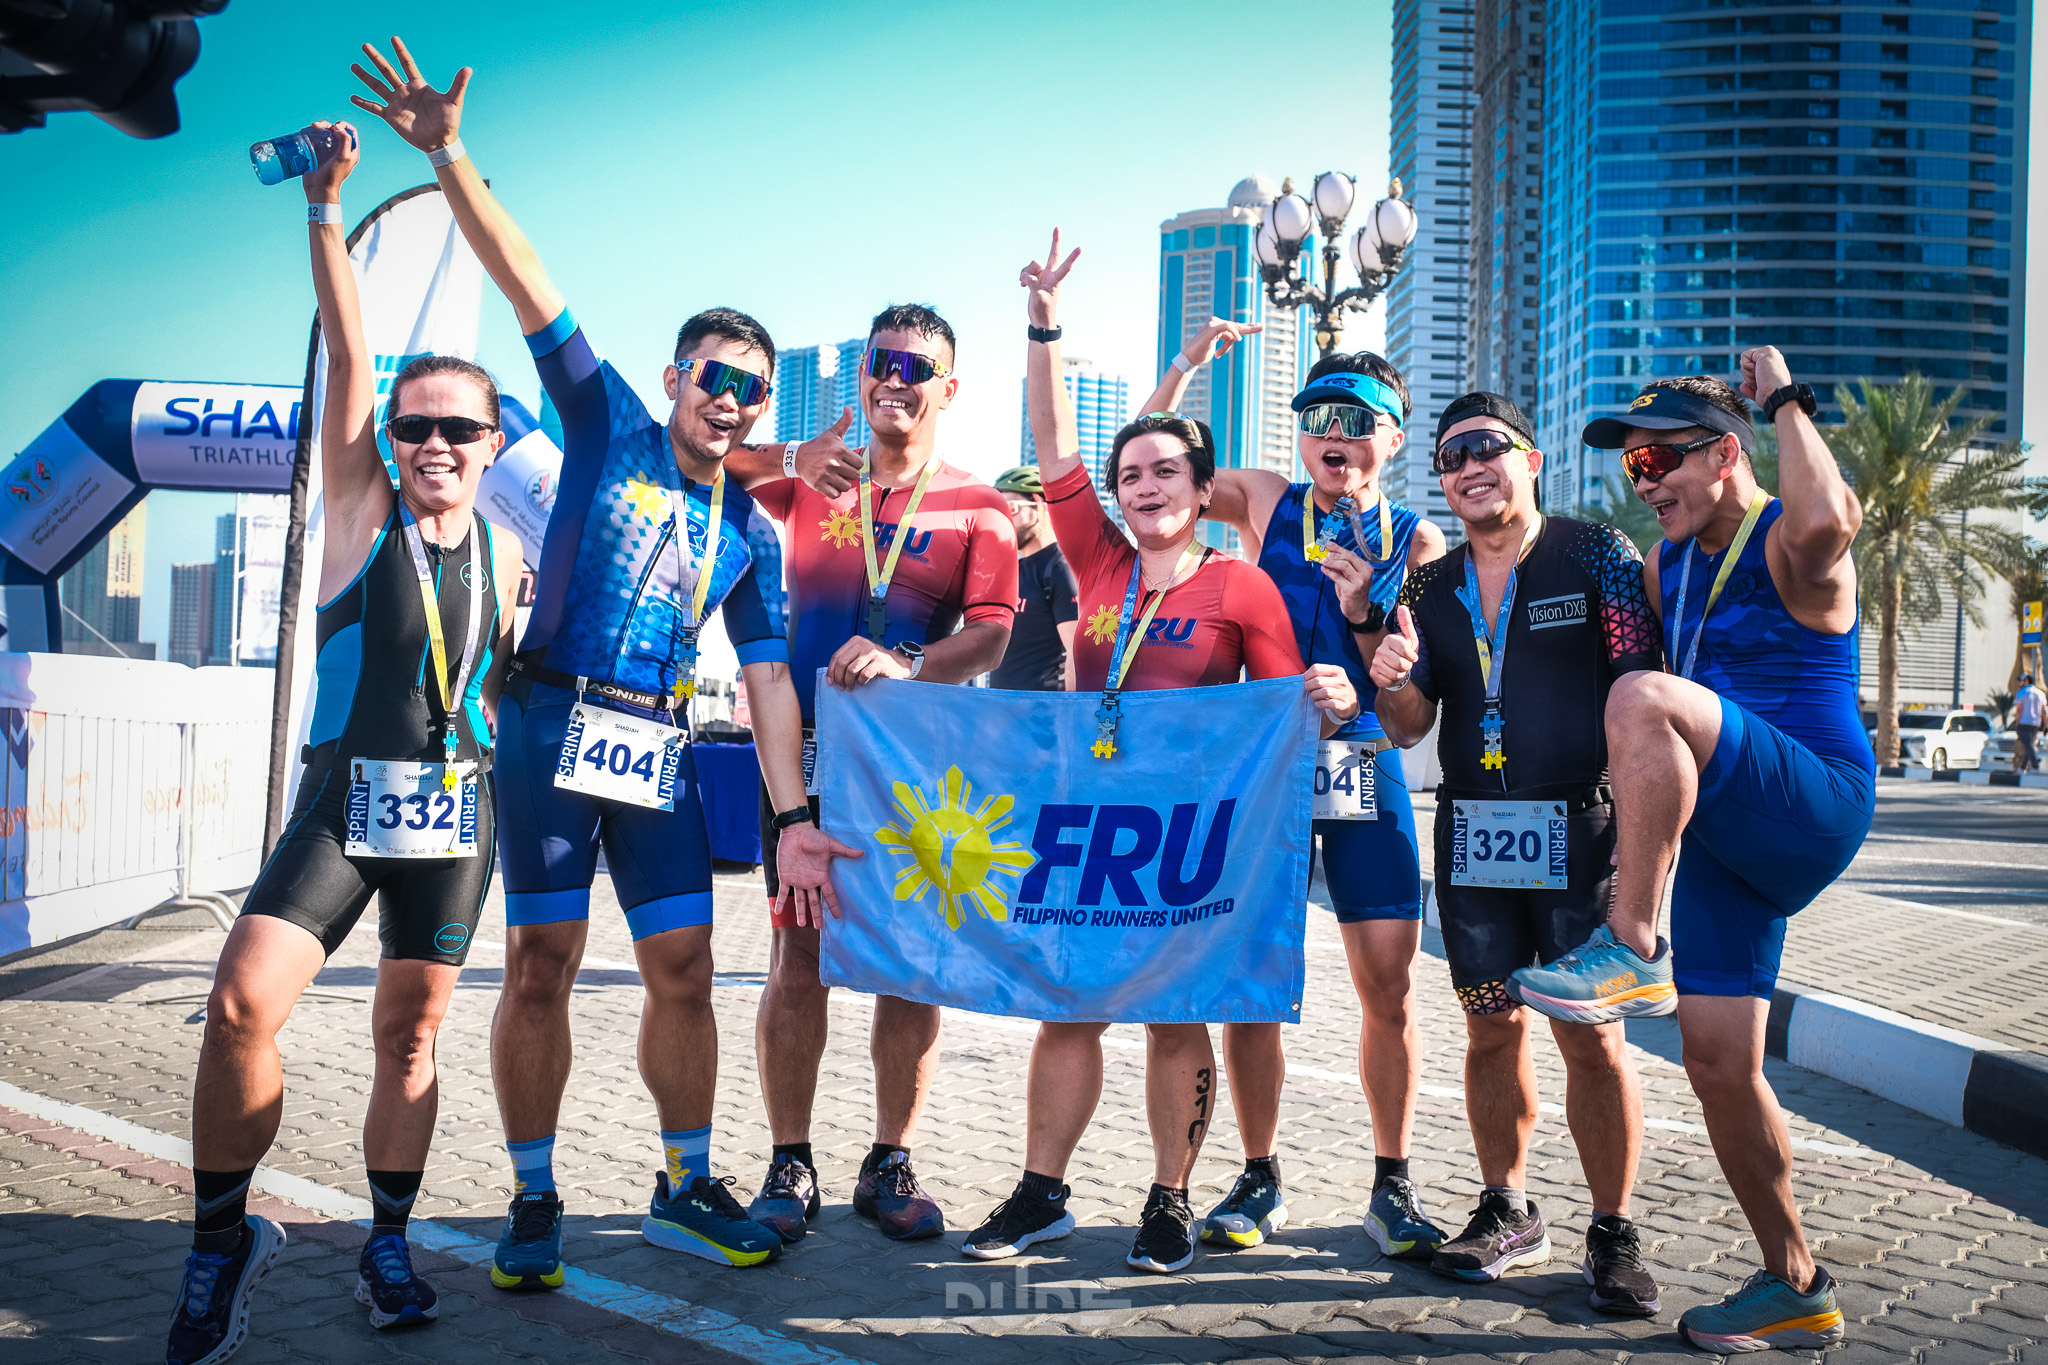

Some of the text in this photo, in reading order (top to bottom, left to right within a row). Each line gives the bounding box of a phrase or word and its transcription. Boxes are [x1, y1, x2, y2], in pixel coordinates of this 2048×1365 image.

[785, 450, 795, 467] 333
[1528, 600, 1587, 623] Vision DXB
[588, 682, 655, 705] AONIJIE
[558, 721, 584, 777] SPRINT
[583, 739, 656, 782] 404
[660, 745, 680, 800] SPRINT
[1314, 766, 1355, 796] 04
[1361, 759, 1375, 810] SPRINT
[349, 783, 368, 842] SPRINT
[376, 794, 455, 830] 332
[461, 783, 475, 841] SPRINT
[1017, 797, 1237, 907] FRU
[1453, 818, 1467, 873] SPRINT
[1472, 829, 1542, 863] 320
[1551, 820, 1566, 876] SPRINT
[1013, 897, 1235, 928] FILIPINO RUNNERS UNITED
[1188, 1067, 1210, 1147] 310
[522, 1194, 543, 1202] HOKA
